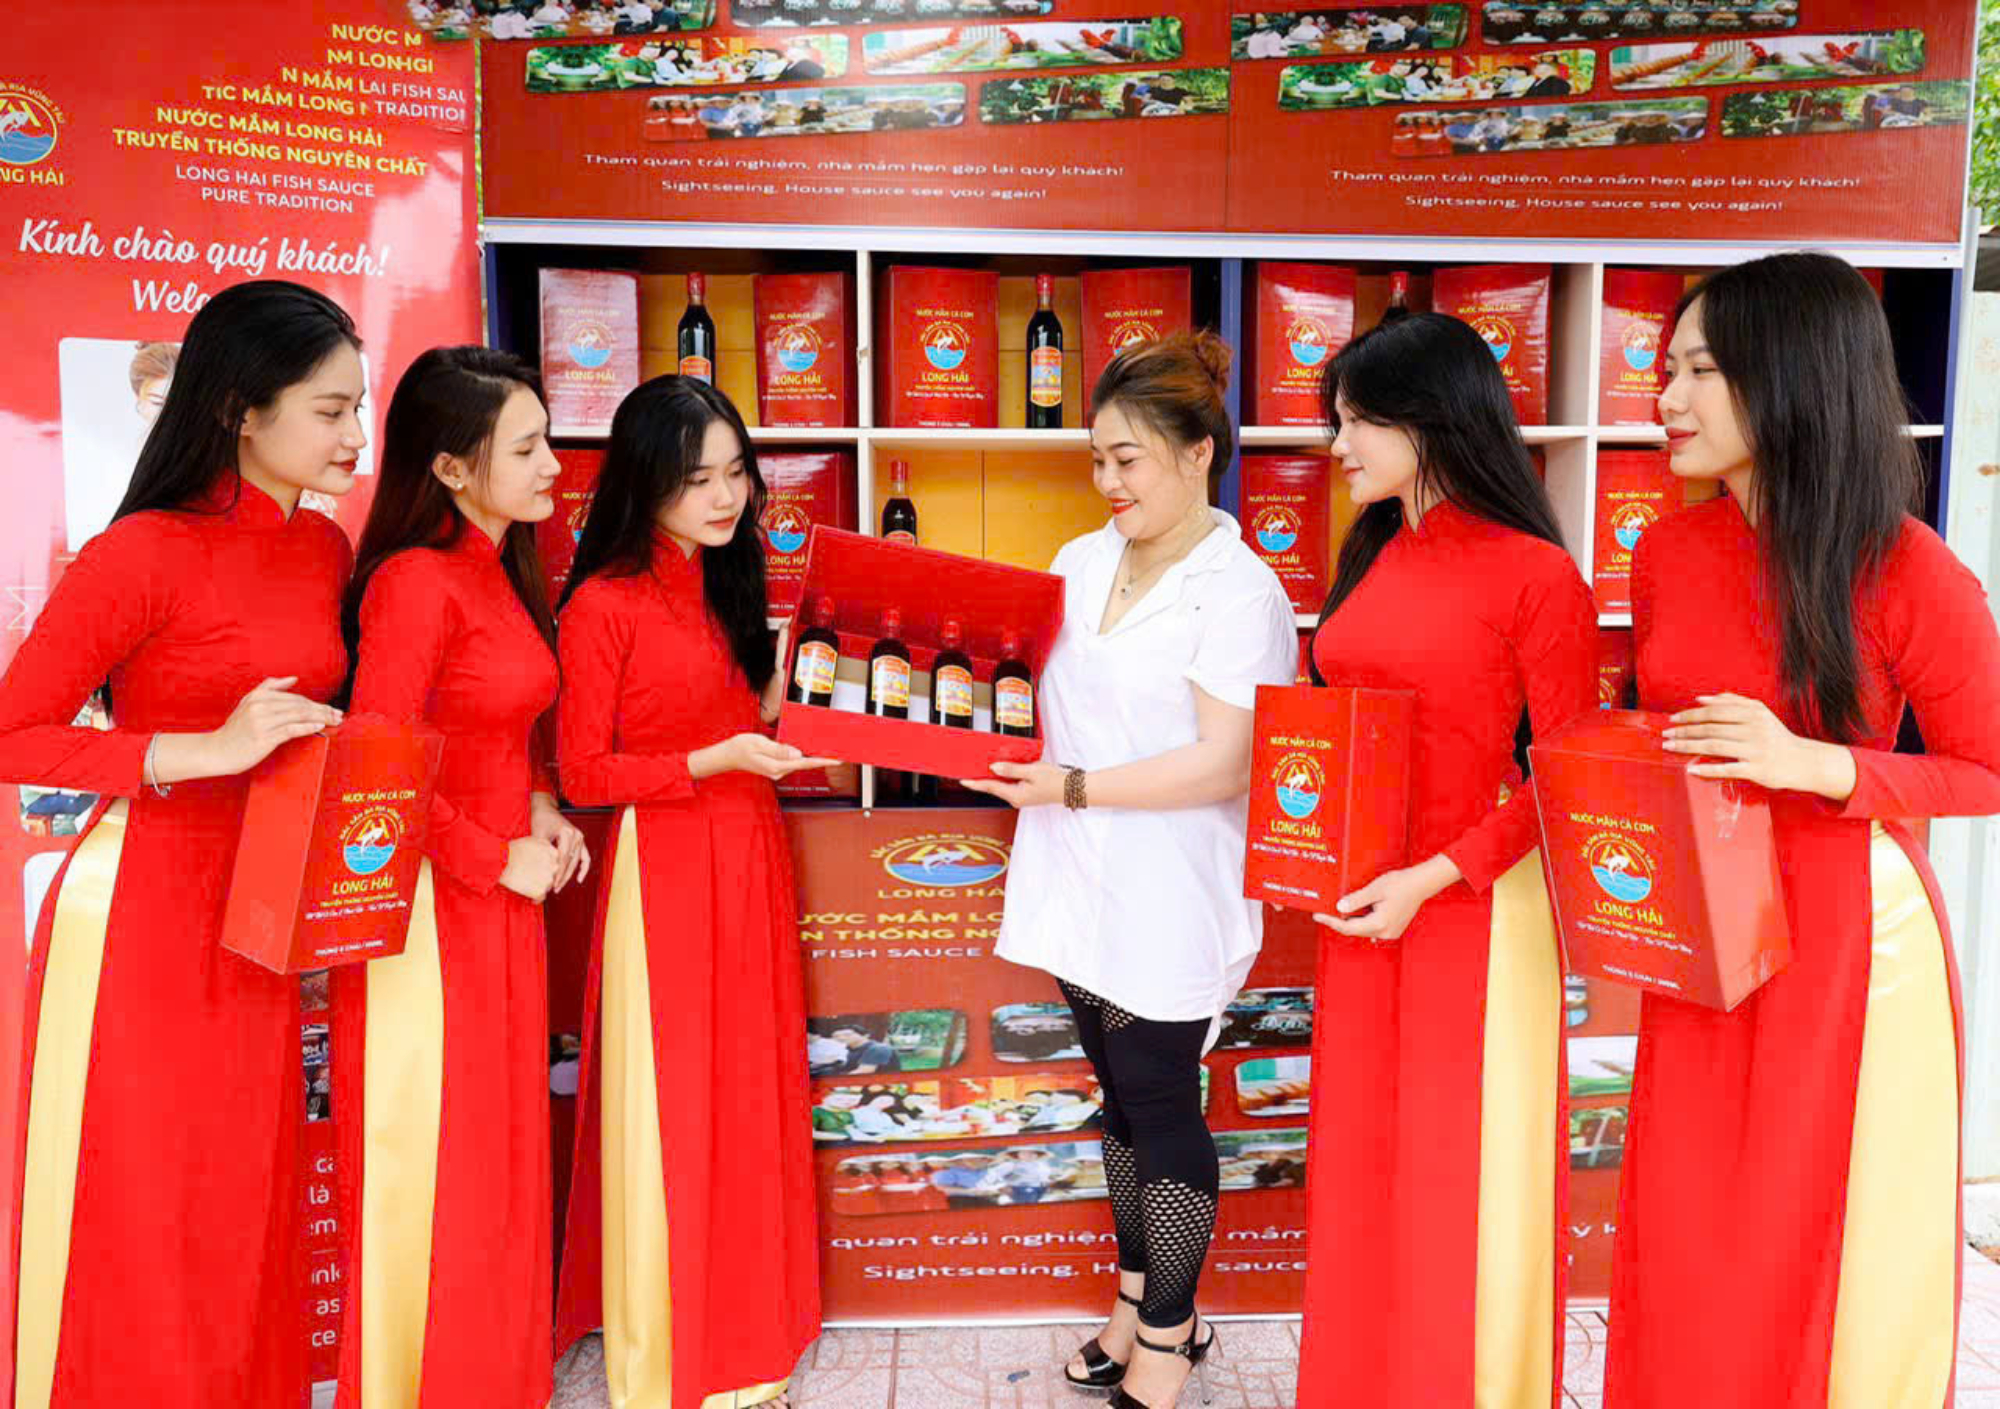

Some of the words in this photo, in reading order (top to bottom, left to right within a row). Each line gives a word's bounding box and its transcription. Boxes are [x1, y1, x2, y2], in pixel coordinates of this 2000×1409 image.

[332, 24, 399, 45] NƯỚC
[392, 82, 432, 99] FISH
[299, 94, 354, 115] LONG
[157, 107, 224, 128] NƯỚC
[229, 112, 279, 136] MẮM
[285, 121, 344, 142] LONG
[349, 127, 383, 148] HẢI
[112, 128, 199, 152] TRUYỀN
[204, 138, 282, 161] THỐNG
[287, 147, 371, 170] NGUYÊN
[376, 156, 427, 177] CHẤT
[583, 154, 638, 166] Tham
[643, 157, 691, 168] quan
[30, 166, 64, 187] HẢI
[175, 164, 231, 183] LONG
[236, 170, 267, 187] HAI
[272, 174, 313, 191] FISH
[318, 179, 375, 198] SAUCE
[1330, 170, 1384, 182] Tham
[1388, 173, 1436, 183] quan
[202, 187, 250, 205] PURE
[255, 190, 354, 214] TRADITION
[785, 184, 845, 195] House
[850, 186, 905, 197] sauce
[911, 187, 944, 197] see
[949, 187, 985, 199] you
[990, 188, 1048, 201] again!
[1526, 197, 1586, 208] House
[1591, 200, 1644, 210] sauce
[1649, 200, 1682, 210] see
[1687, 201, 1722, 212] you
[1728, 201, 1784, 212] again!
[19, 218, 106, 258] Kính
[113, 226, 200, 263] chào
[206, 237, 270, 276] quý
[277, 237, 391, 277] khách!
[774, 375, 801, 386] LONG
[921, 373, 949, 383] LONG
[1271, 819, 1300, 836] LONG
[332, 879, 368, 896] LONG
[372, 875, 395, 891] HẢI
[877, 888, 956, 899] LONG
[797, 912, 868, 925] ƯỚC
[877, 908, 957, 924] MẮM
[968, 912, 1004, 923] LO
[1594, 900, 1634, 920] LONG
[1637, 907, 1663, 926] HẢI
[834, 925, 956, 941] THỐNG
[812, 948, 877, 959] FISH
[887, 947, 982, 959] SAUCE
[831, 1235, 918, 1250] quan
[930, 1231, 988, 1246] trải
